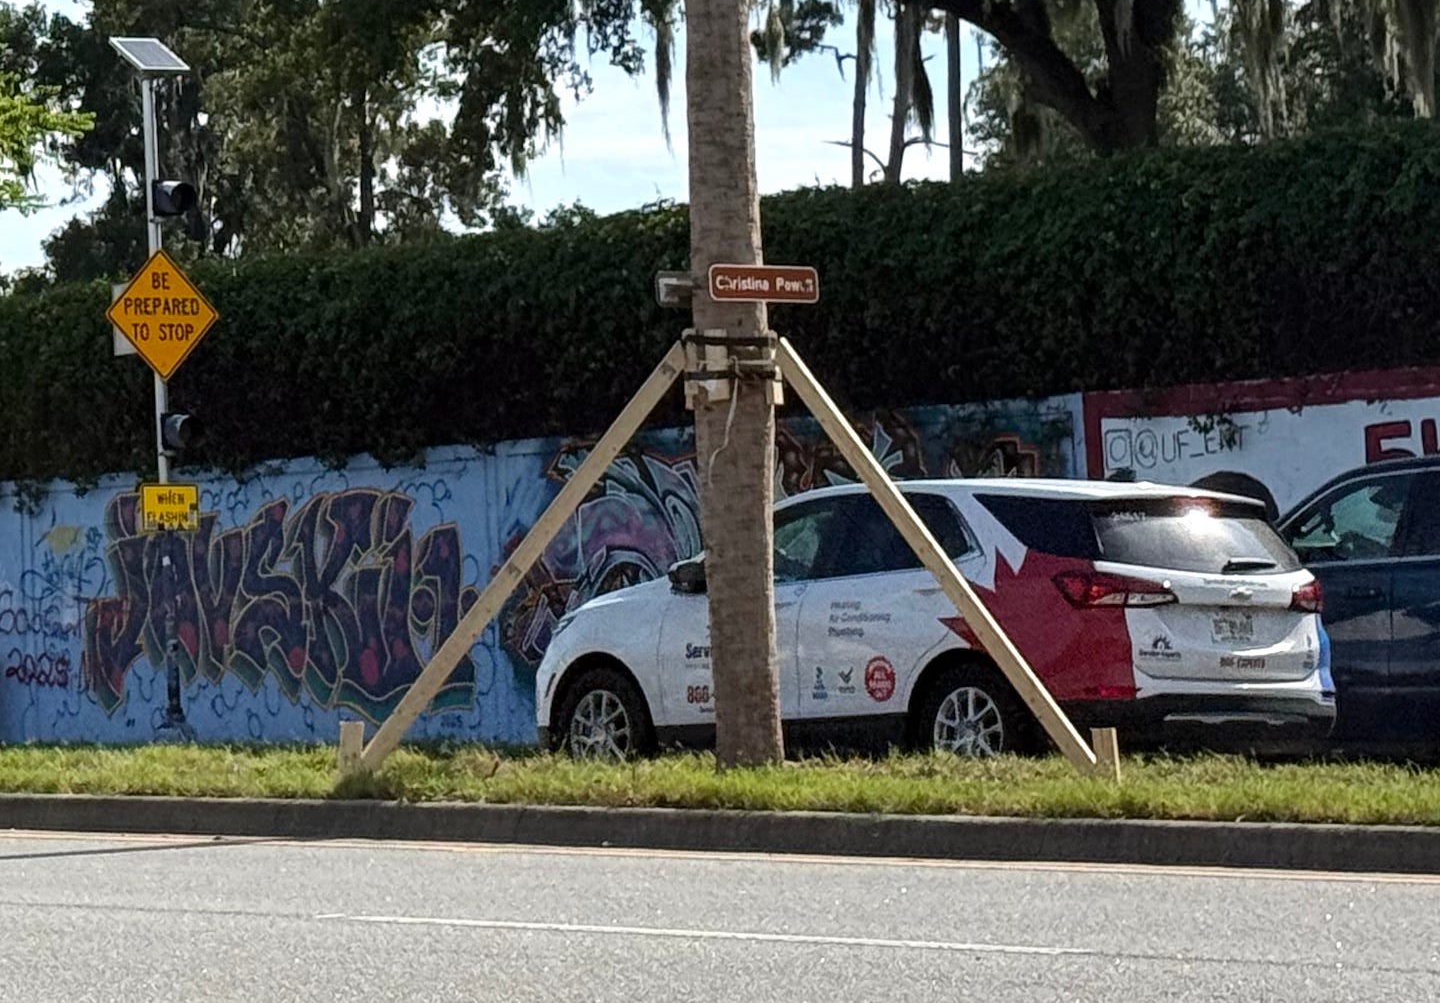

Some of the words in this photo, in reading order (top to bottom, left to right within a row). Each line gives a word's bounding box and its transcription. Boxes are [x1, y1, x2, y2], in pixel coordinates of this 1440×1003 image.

[151, 272, 170, 290] BE
[123, 297, 200, 316] PREPARED
[132, 323, 149, 341] TO
[159, 324, 194, 341] STOP
[156, 490, 185, 505] WHEN
[147, 511, 193, 523] FLASHIN
